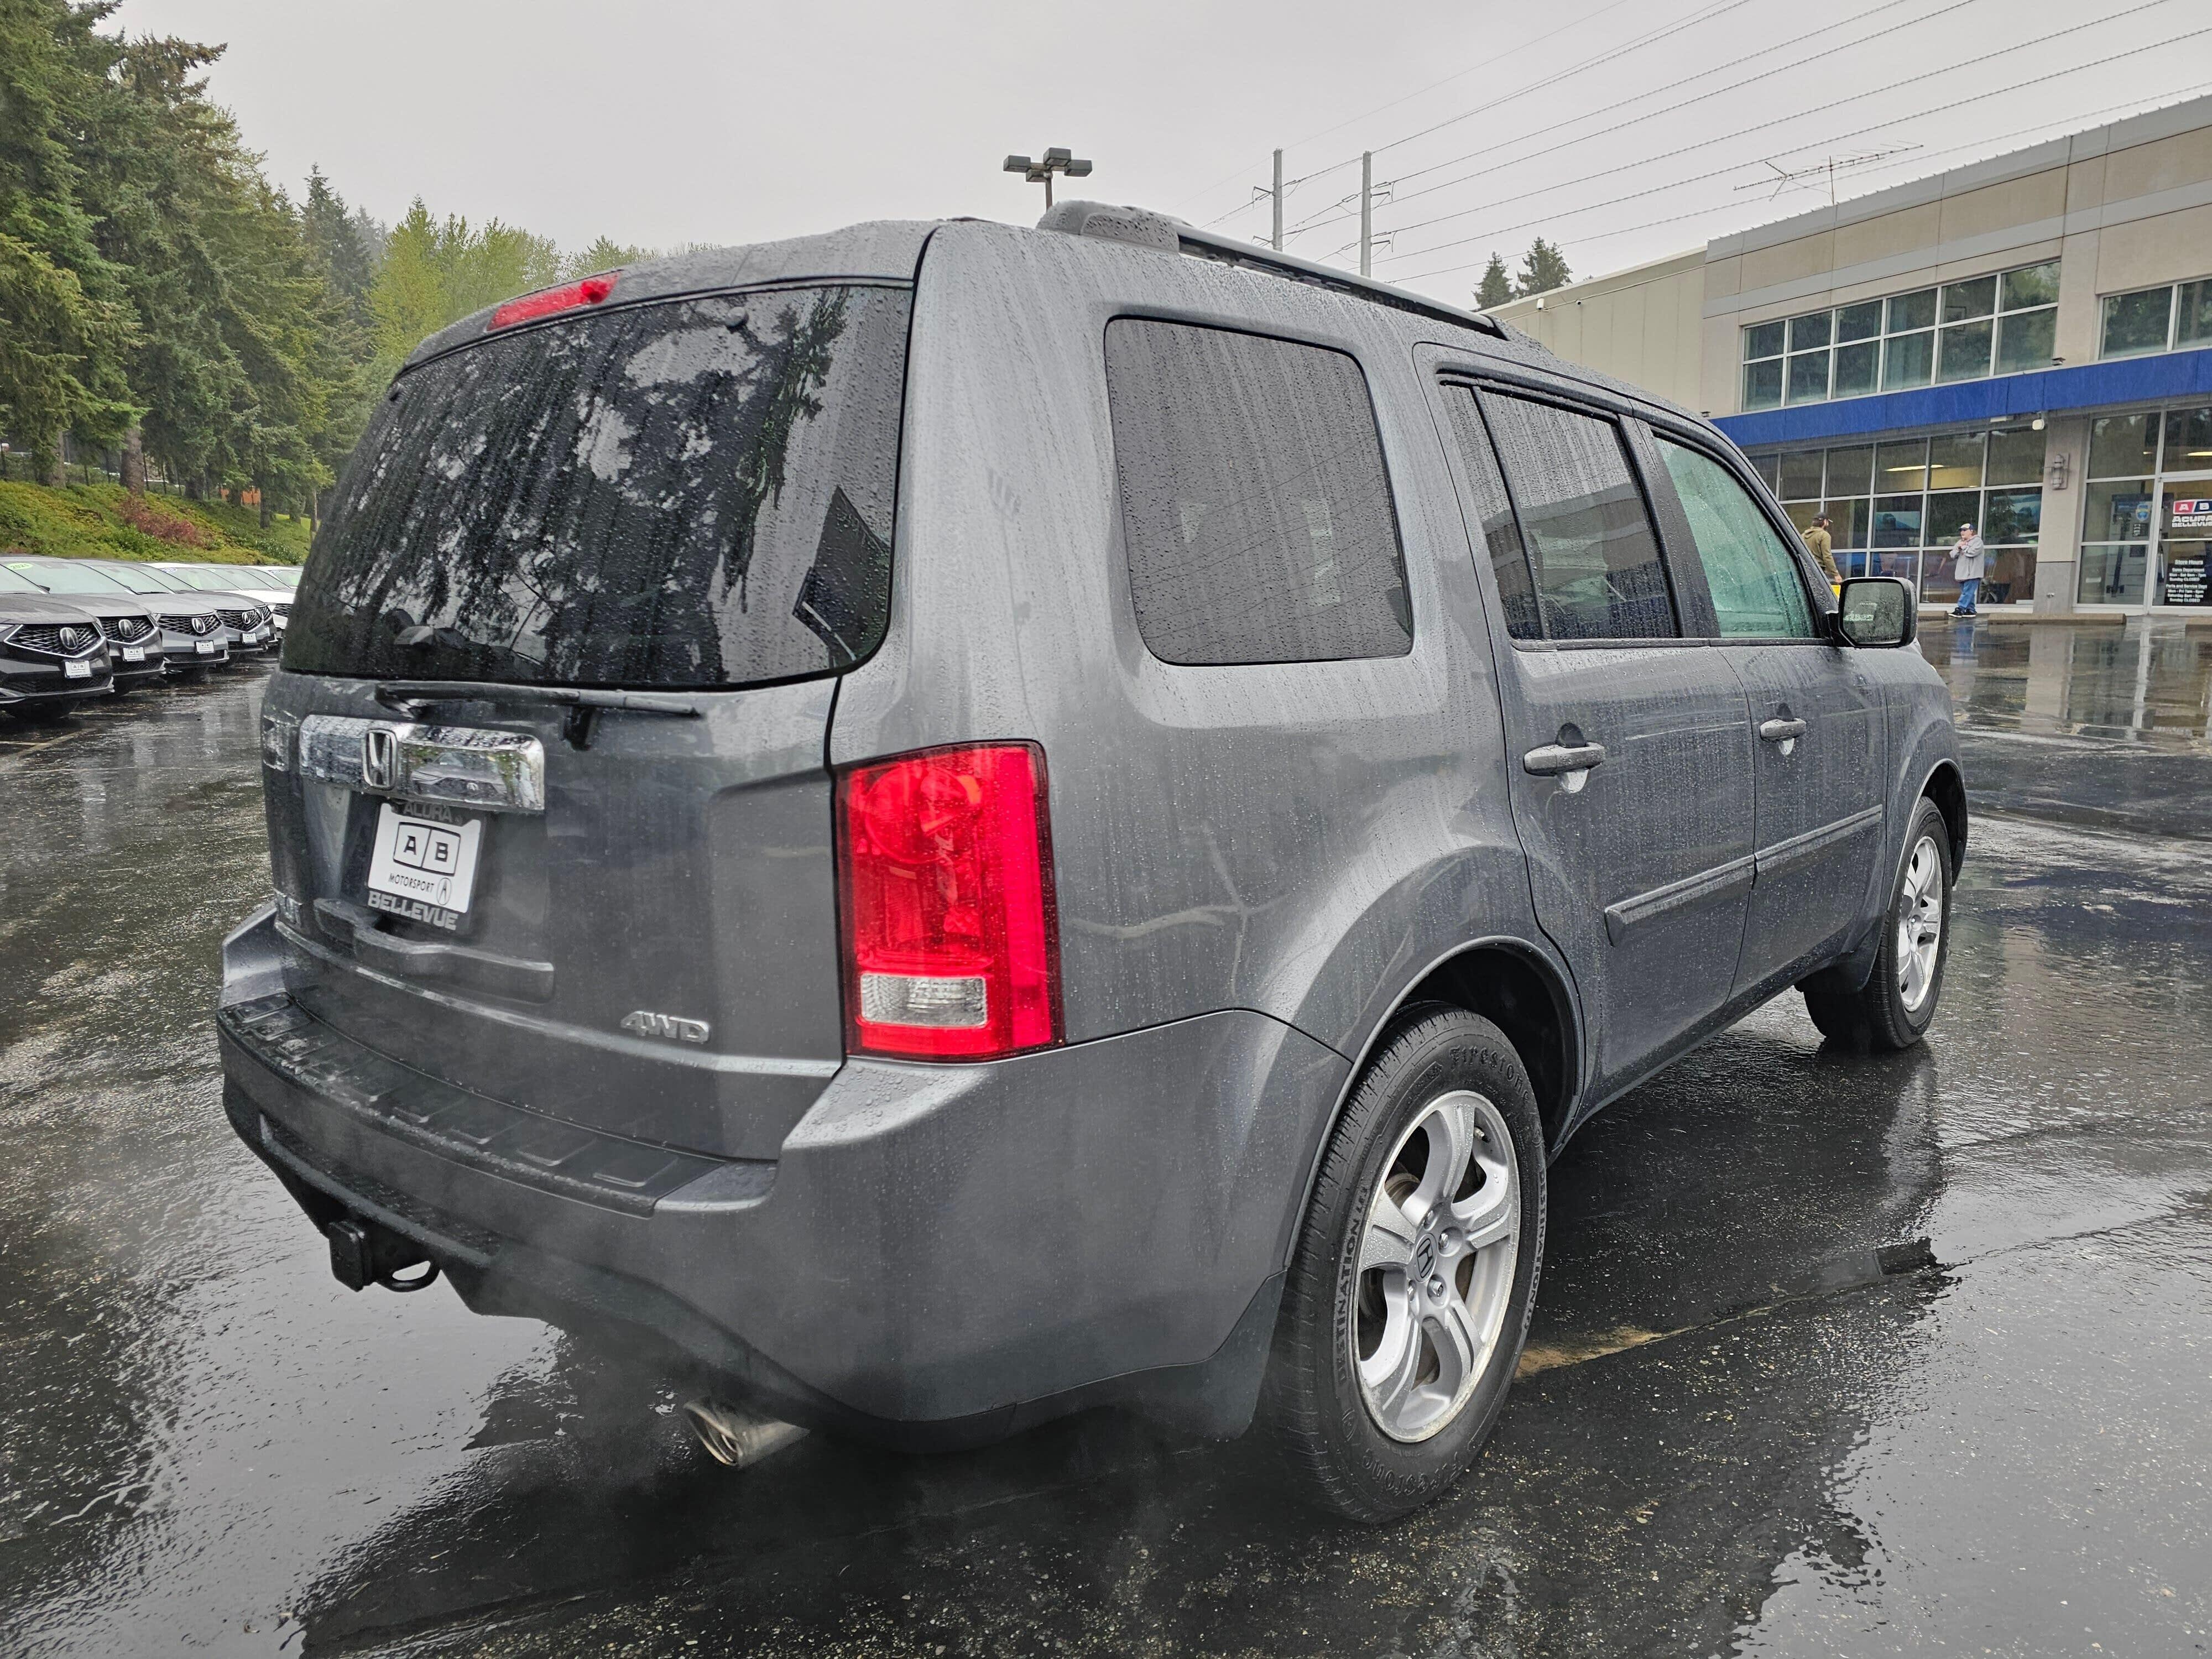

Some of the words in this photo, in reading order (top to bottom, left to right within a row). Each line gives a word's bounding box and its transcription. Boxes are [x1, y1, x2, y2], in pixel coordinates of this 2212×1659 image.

[389, 873, 435, 893] MOTORSPORT
[368, 890, 459, 930] BELLEVUE
[1335, 1218, 1360, 1380] DESTINATION
